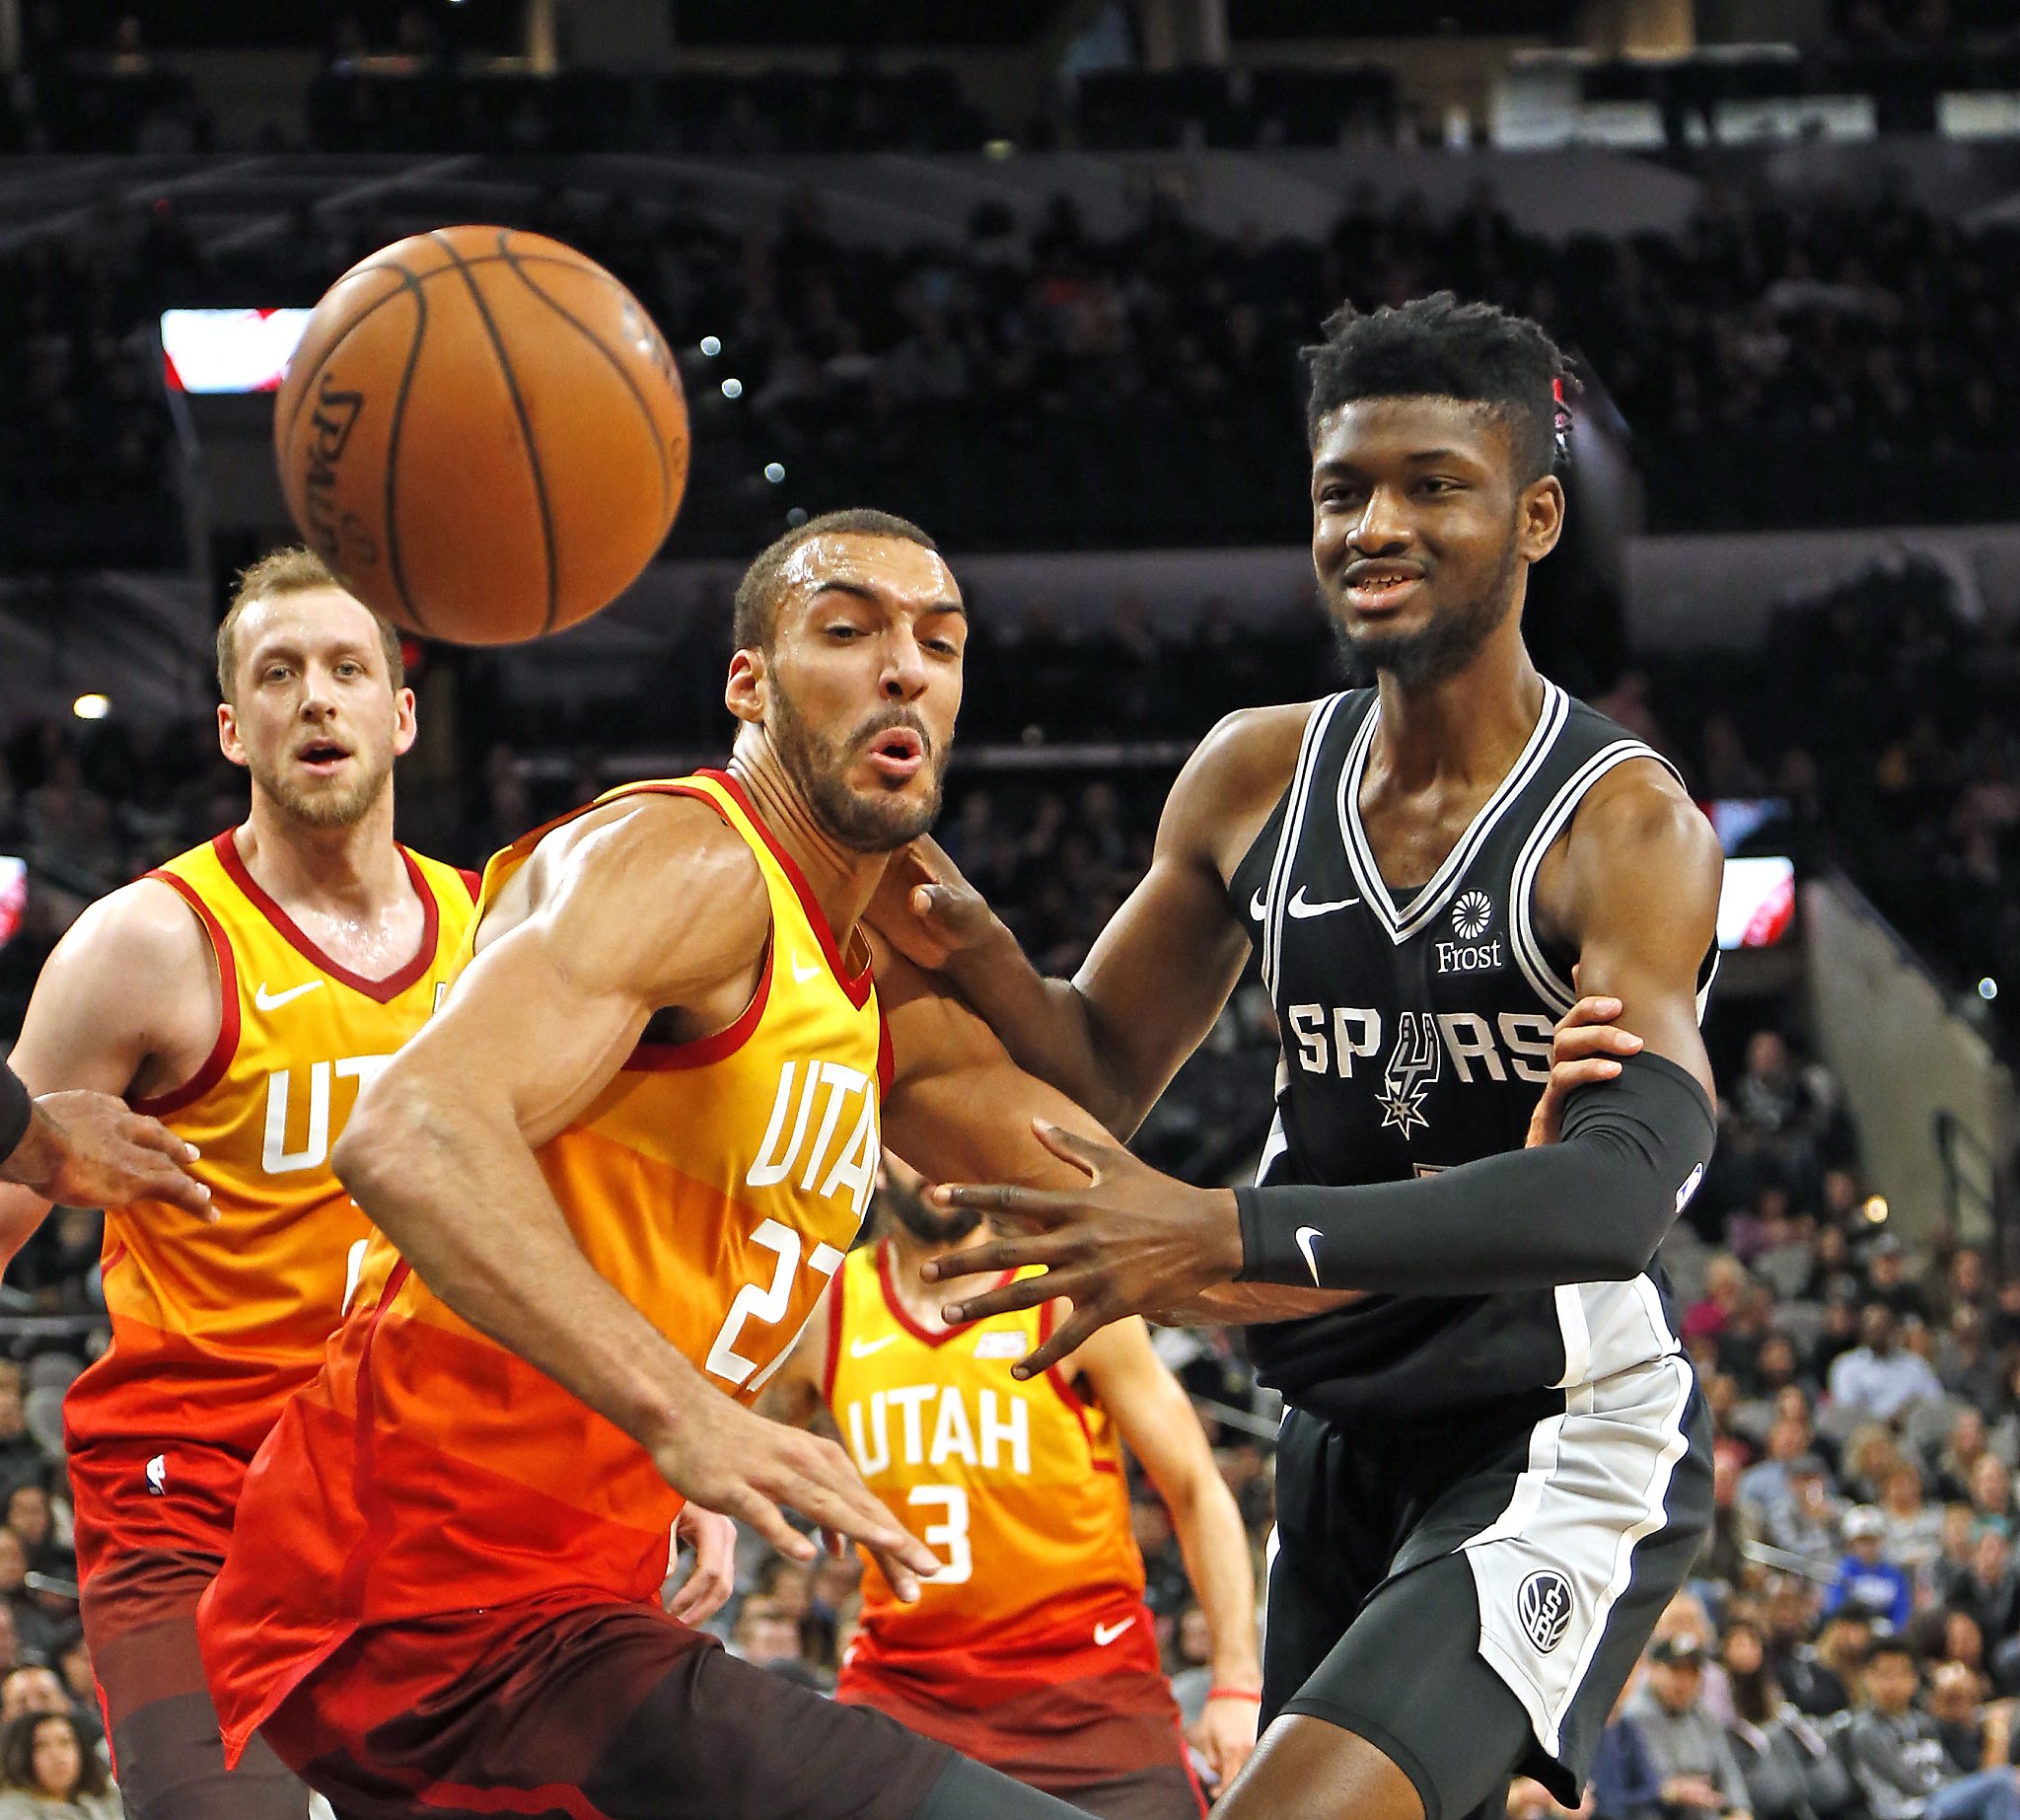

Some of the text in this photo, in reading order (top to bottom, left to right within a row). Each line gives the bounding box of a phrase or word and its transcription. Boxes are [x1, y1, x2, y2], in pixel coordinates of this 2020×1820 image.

[1435, 939, 1502, 974] Frost
[1288, 1004, 1555, 1084] SPURS
[746, 1059, 880, 1221] UTA
[848, 1385, 1031, 1477] UTAH
[907, 1485, 973, 1584] 3
